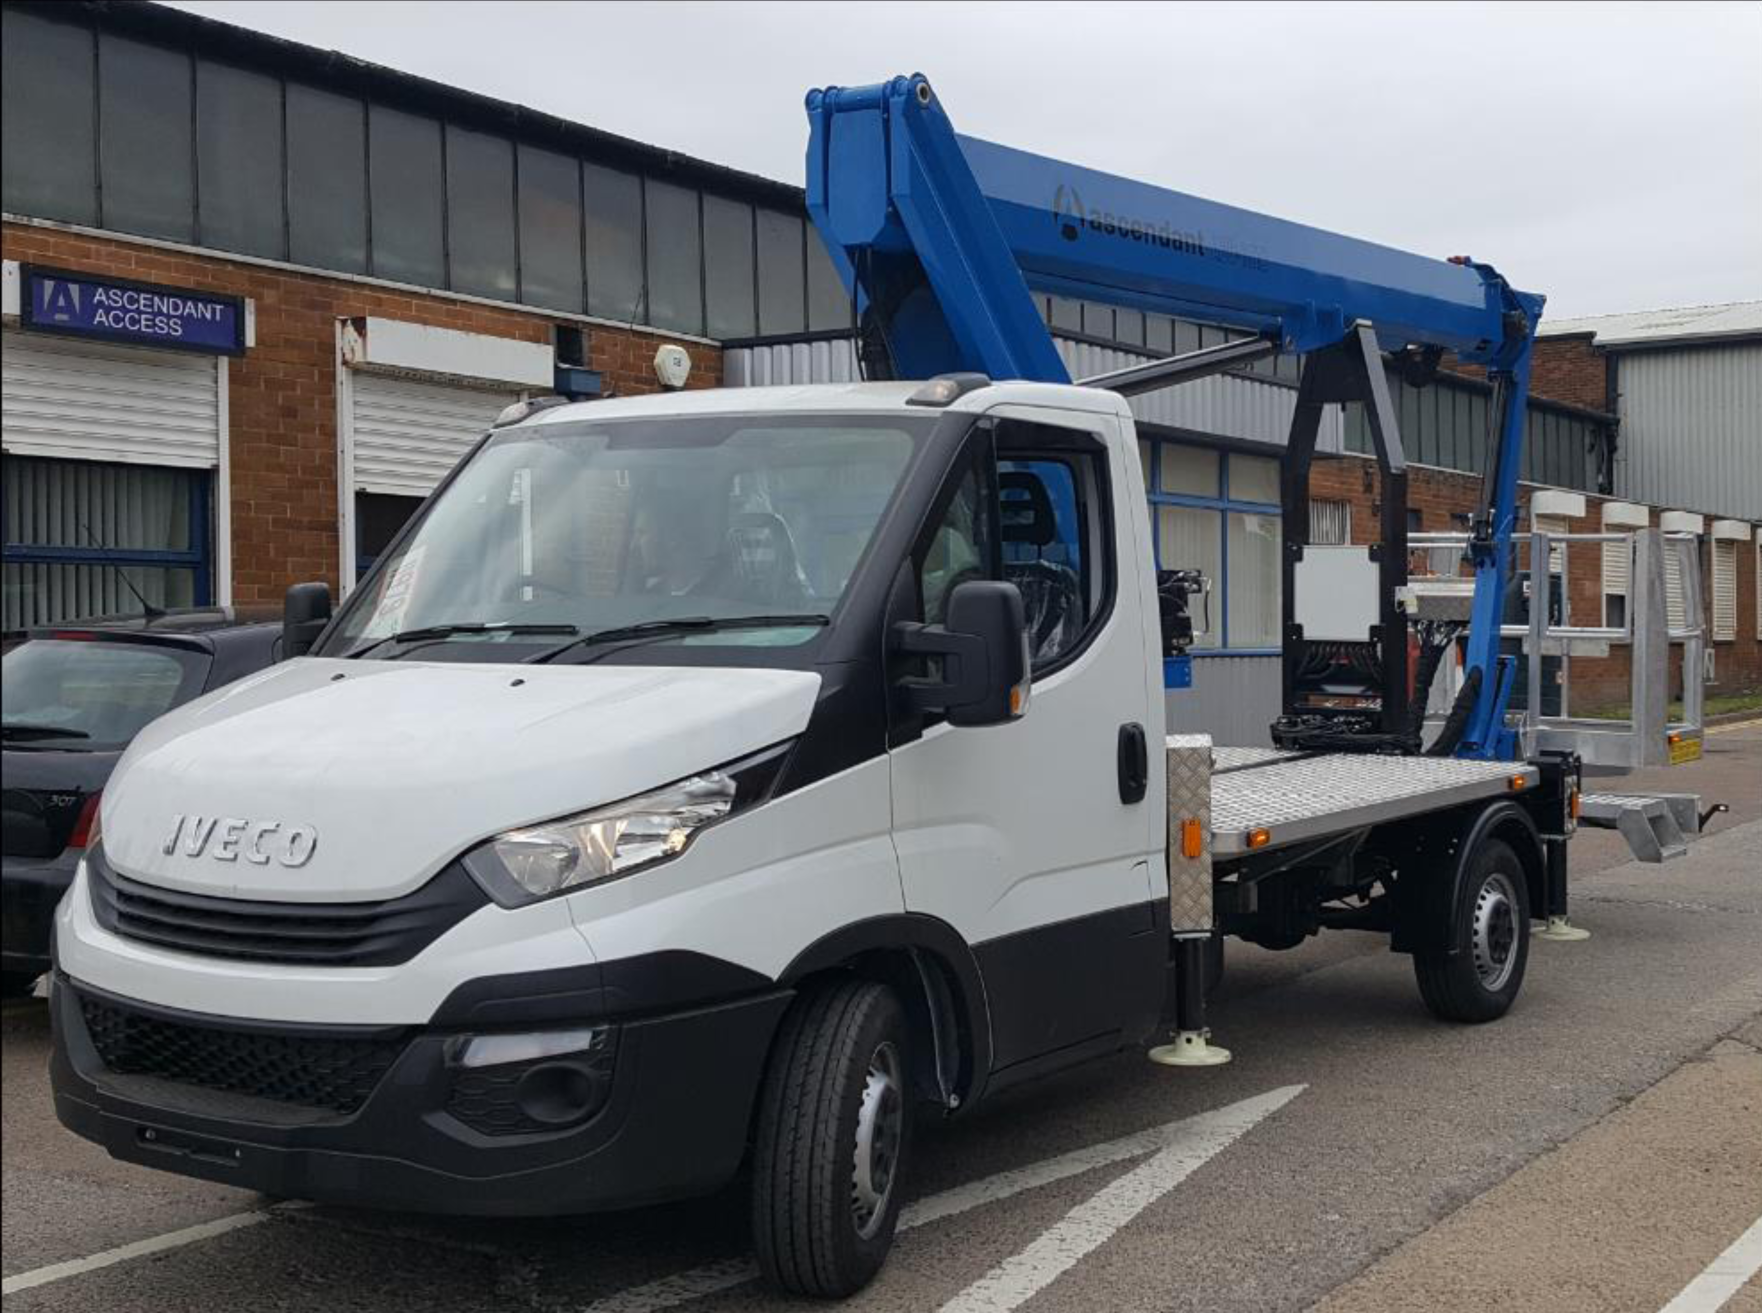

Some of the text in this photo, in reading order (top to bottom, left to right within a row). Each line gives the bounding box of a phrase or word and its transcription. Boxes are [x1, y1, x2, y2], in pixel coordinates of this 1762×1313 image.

[1089, 207, 1205, 256] ascendant
[93, 287, 224, 322] ASCENDANT
[93, 309, 183, 336] ACCESS
[162, 813, 318, 868] IVECO
